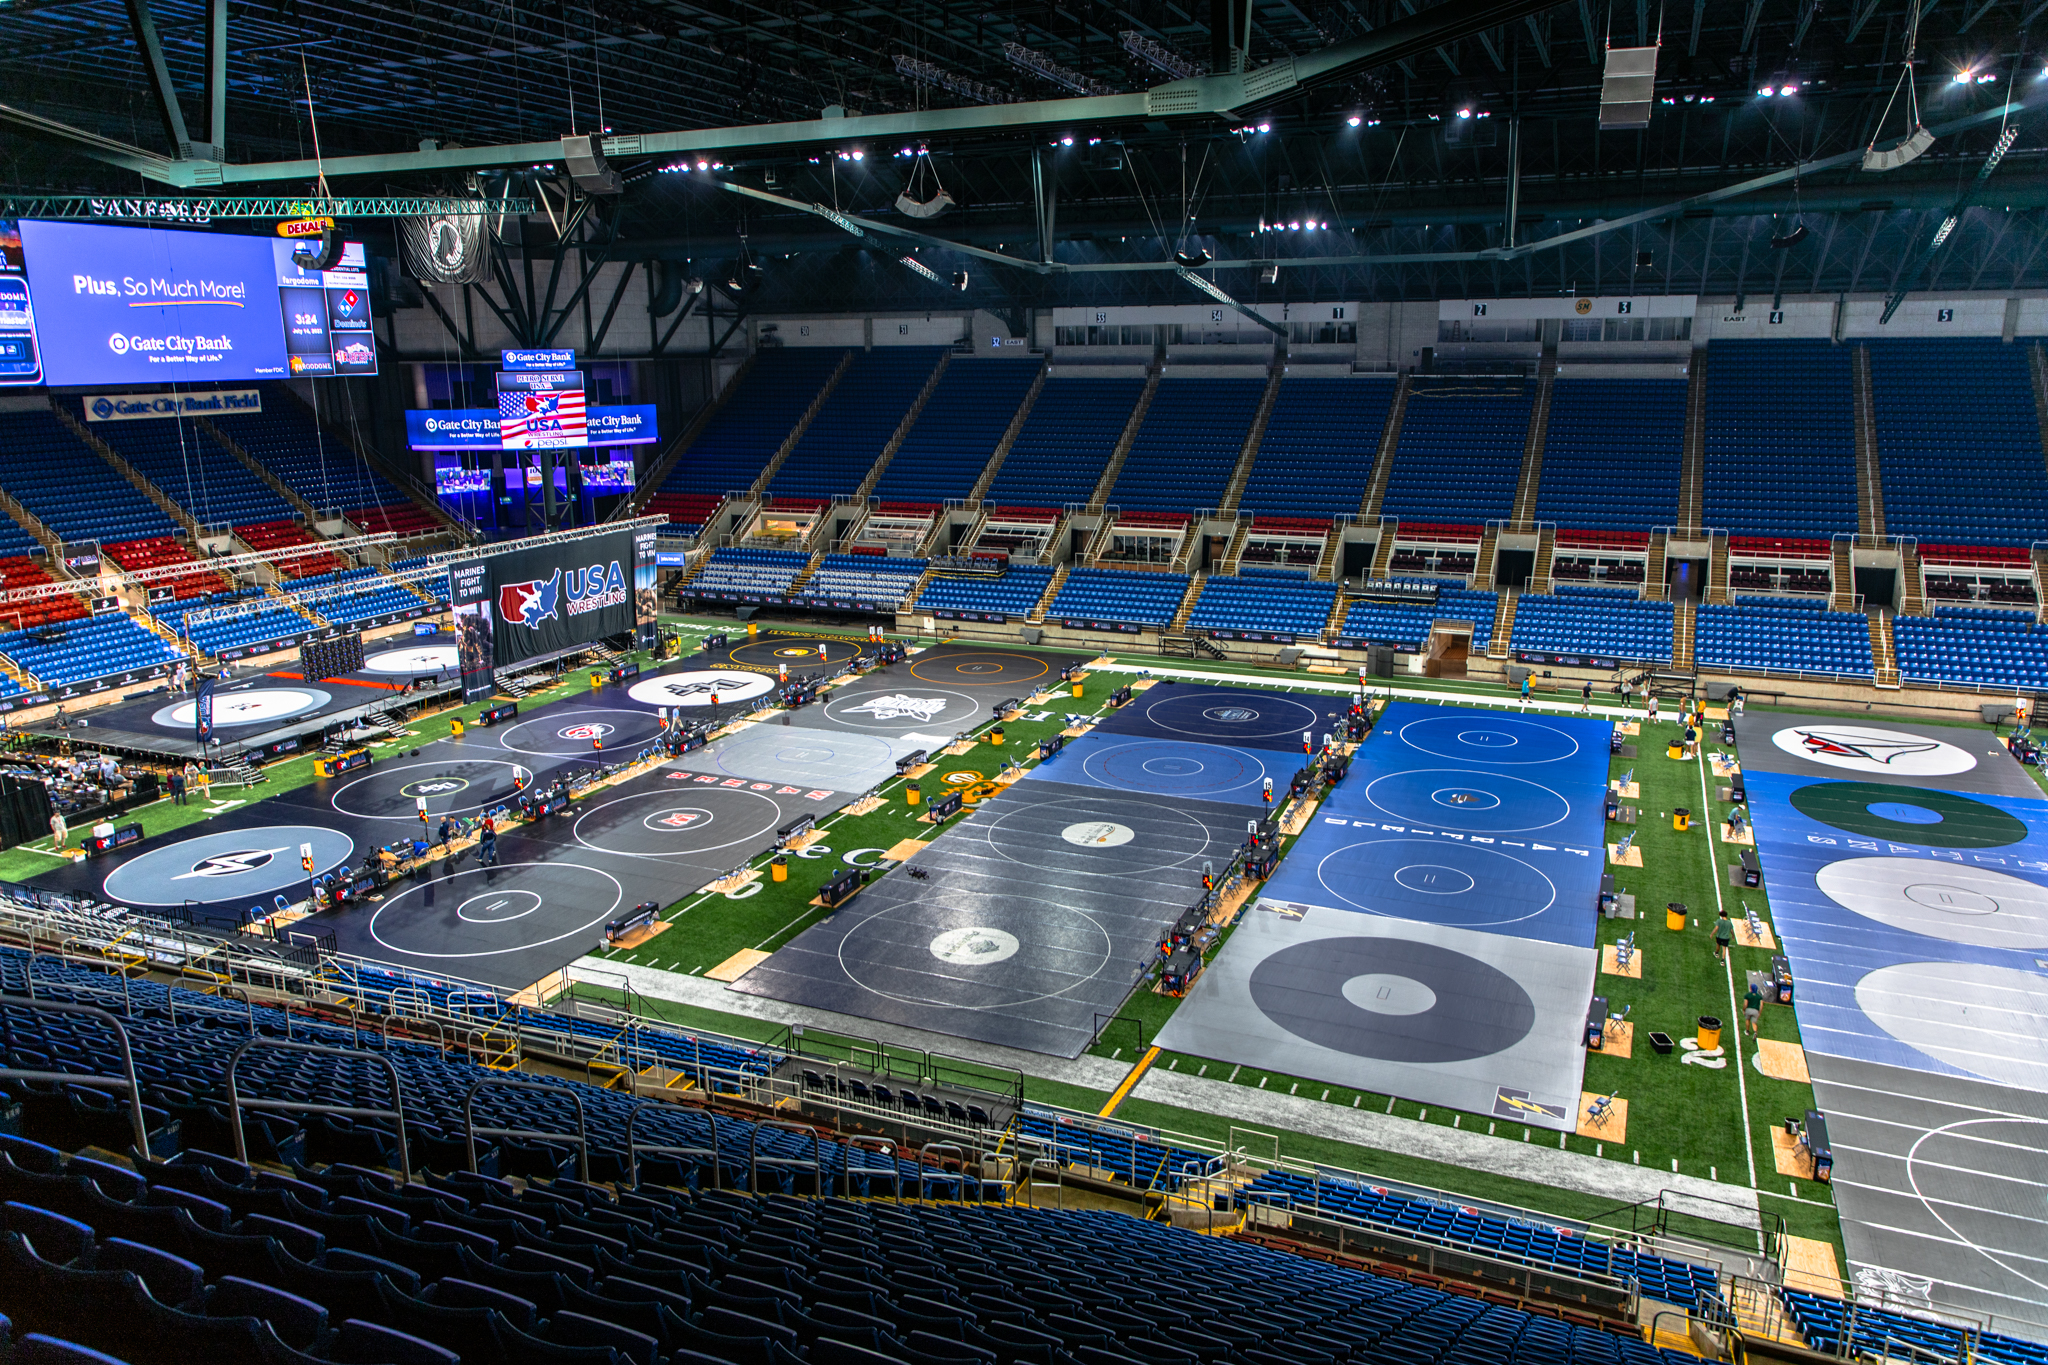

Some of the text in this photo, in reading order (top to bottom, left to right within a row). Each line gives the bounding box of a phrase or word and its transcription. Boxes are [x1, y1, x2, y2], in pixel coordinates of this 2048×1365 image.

[73, 275, 246, 298] Plus, So Much More!
[282, 276, 319, 285] fargodome
[295, 314, 317, 325] 3:24
[1097, 312, 1105, 323] 33
[1212, 310, 1222, 321] 34
[1772, 312, 1780, 323] 4
[130, 335, 232, 354] Gate City Bank
[516, 352, 571, 362] Gate City Bank
[115, 393, 258, 415] Gate City Bank Field
[438, 420, 461, 430] Gate
[462, 419, 482, 433] City
[526, 419, 562, 432] USA
[586, 414, 642, 429] ate City Bank
[538, 438, 568, 448] pepsi
[638, 550, 646, 558] TO
[453, 565, 486, 580] MARINES
[460, 575, 481, 587] FIGHT
[565, 560, 627, 601] USA
[459, 585, 483, 598] TO WIN
[566, 590, 627, 617] WRESTLING
[666, 771, 835, 801] WAGNER
[1264, 781, 1271, 790] 15
[1324, 817, 1589, 857] FAIRFIELD
[354, 878, 373, 891] USA
[1161, 929, 1168, 938] 17
